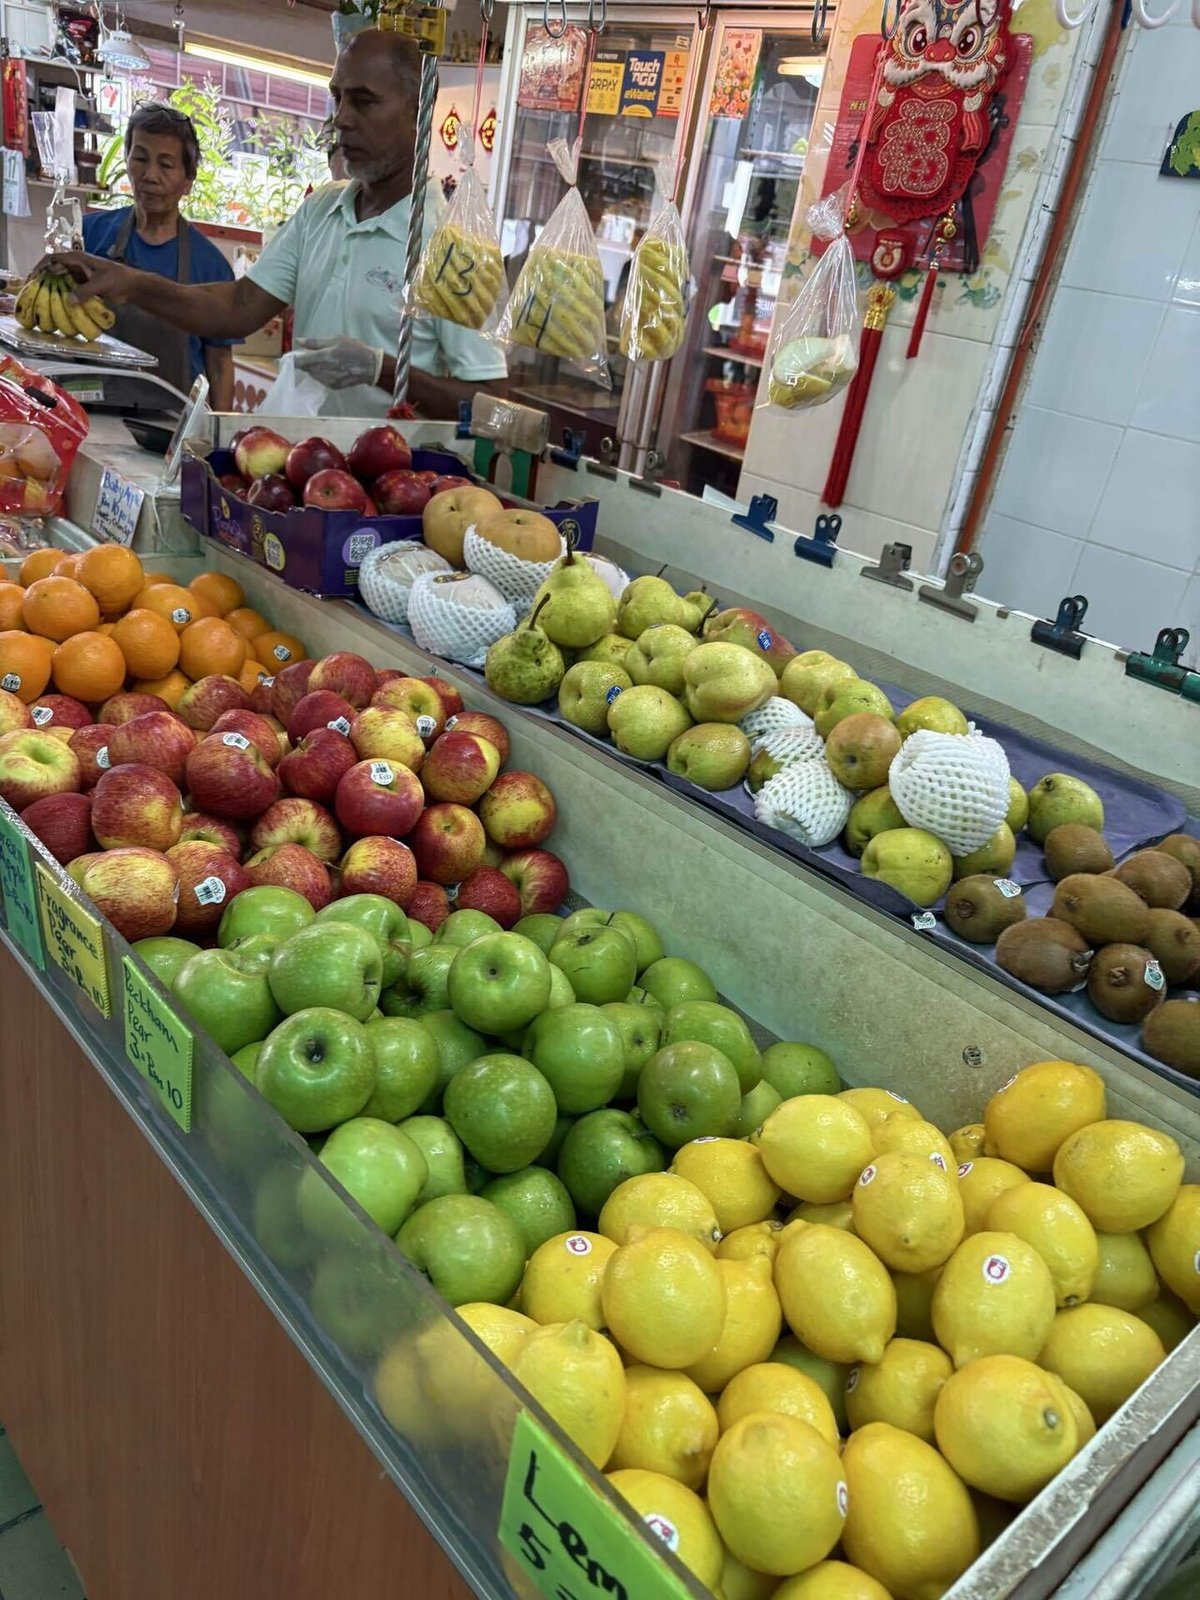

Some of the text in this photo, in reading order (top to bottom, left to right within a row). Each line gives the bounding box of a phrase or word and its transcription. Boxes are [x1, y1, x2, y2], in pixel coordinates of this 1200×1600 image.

[629, 57, 660, 72] Touch
[435, 242, 475, 296] 13
[516, 288, 552, 348] 14
[37, 870, 99, 960] Fragrance
[47, 908, 77, 961] Pear
[128, 999, 153, 1043] Pear
[167, 1079, 184, 1110] 10
